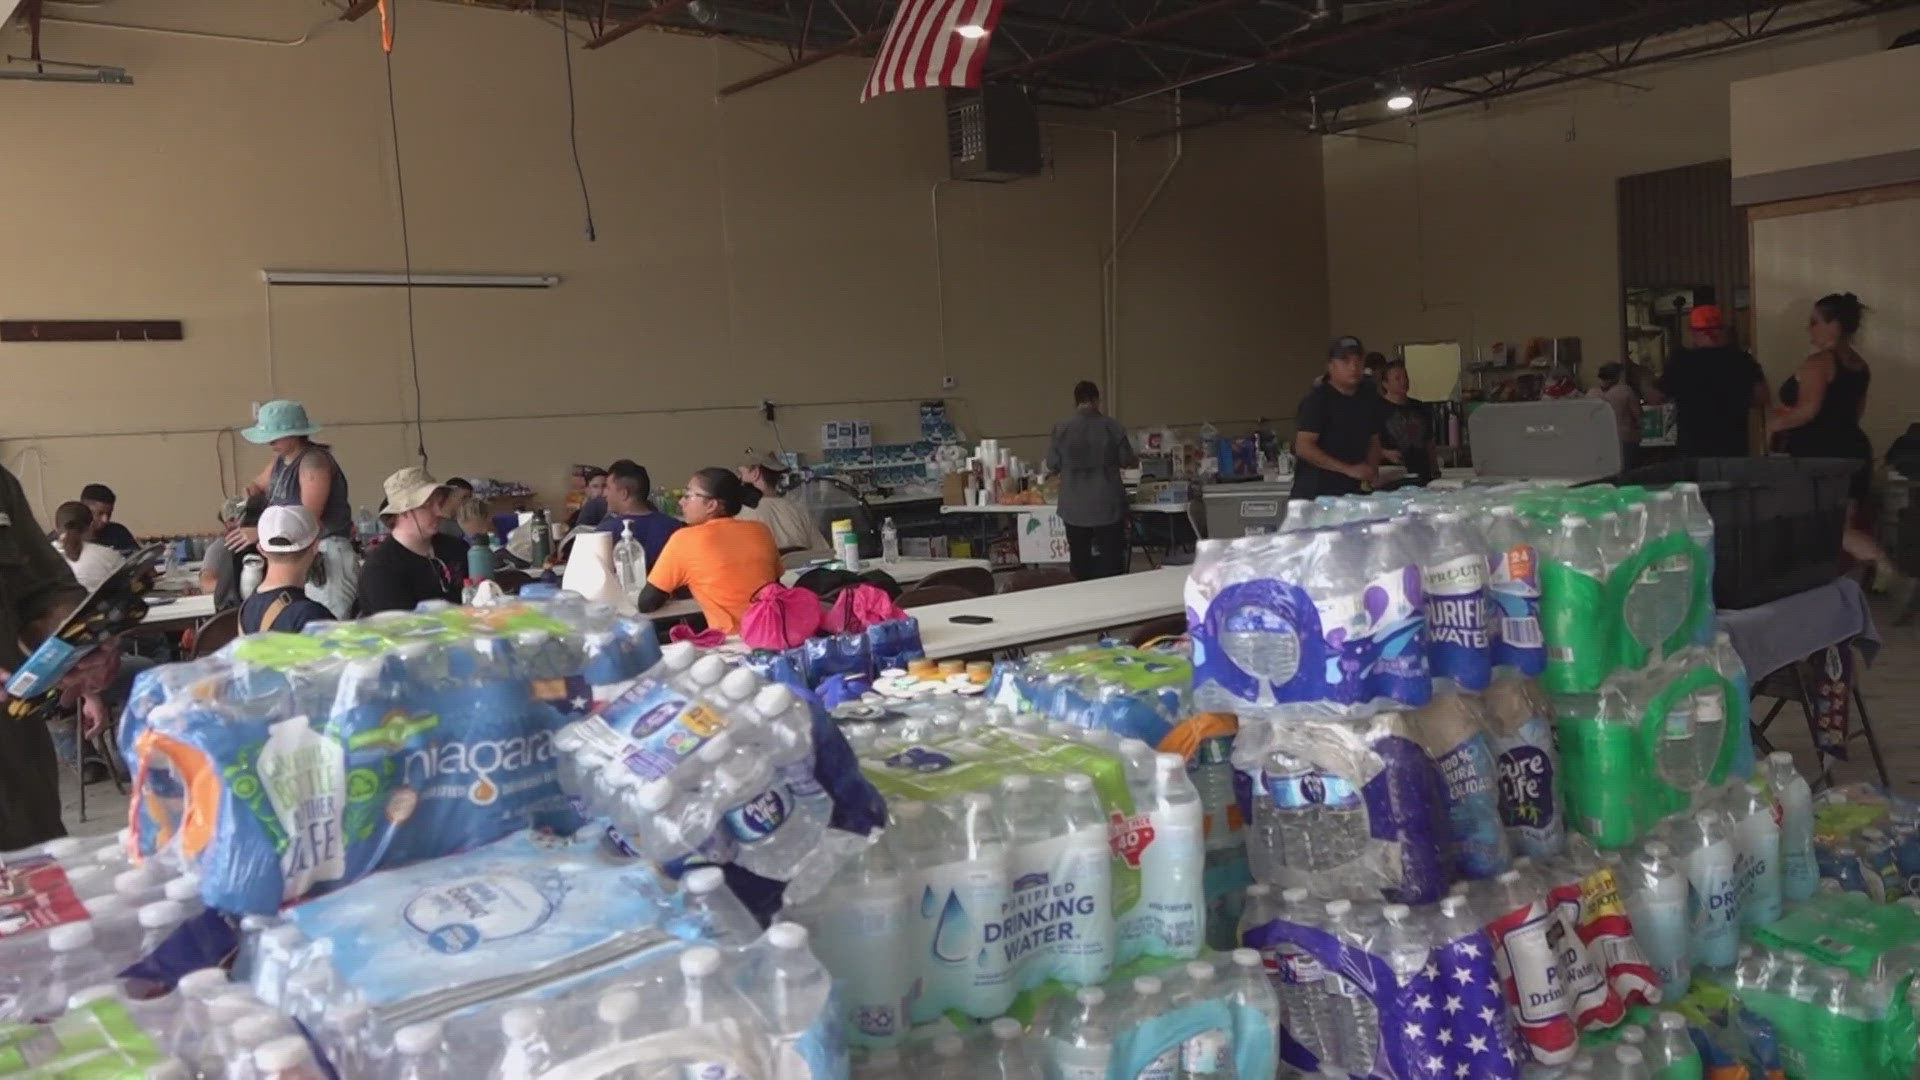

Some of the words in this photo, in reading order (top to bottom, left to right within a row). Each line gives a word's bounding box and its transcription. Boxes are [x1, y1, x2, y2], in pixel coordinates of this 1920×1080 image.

[403, 728, 559, 806] niagara
[1504, 776, 1540, 803] Life
[984, 895, 1095, 943] DRINKING
[1001, 881, 1075, 915] PURIFIED
[1004, 921, 1073, 963] WATER
